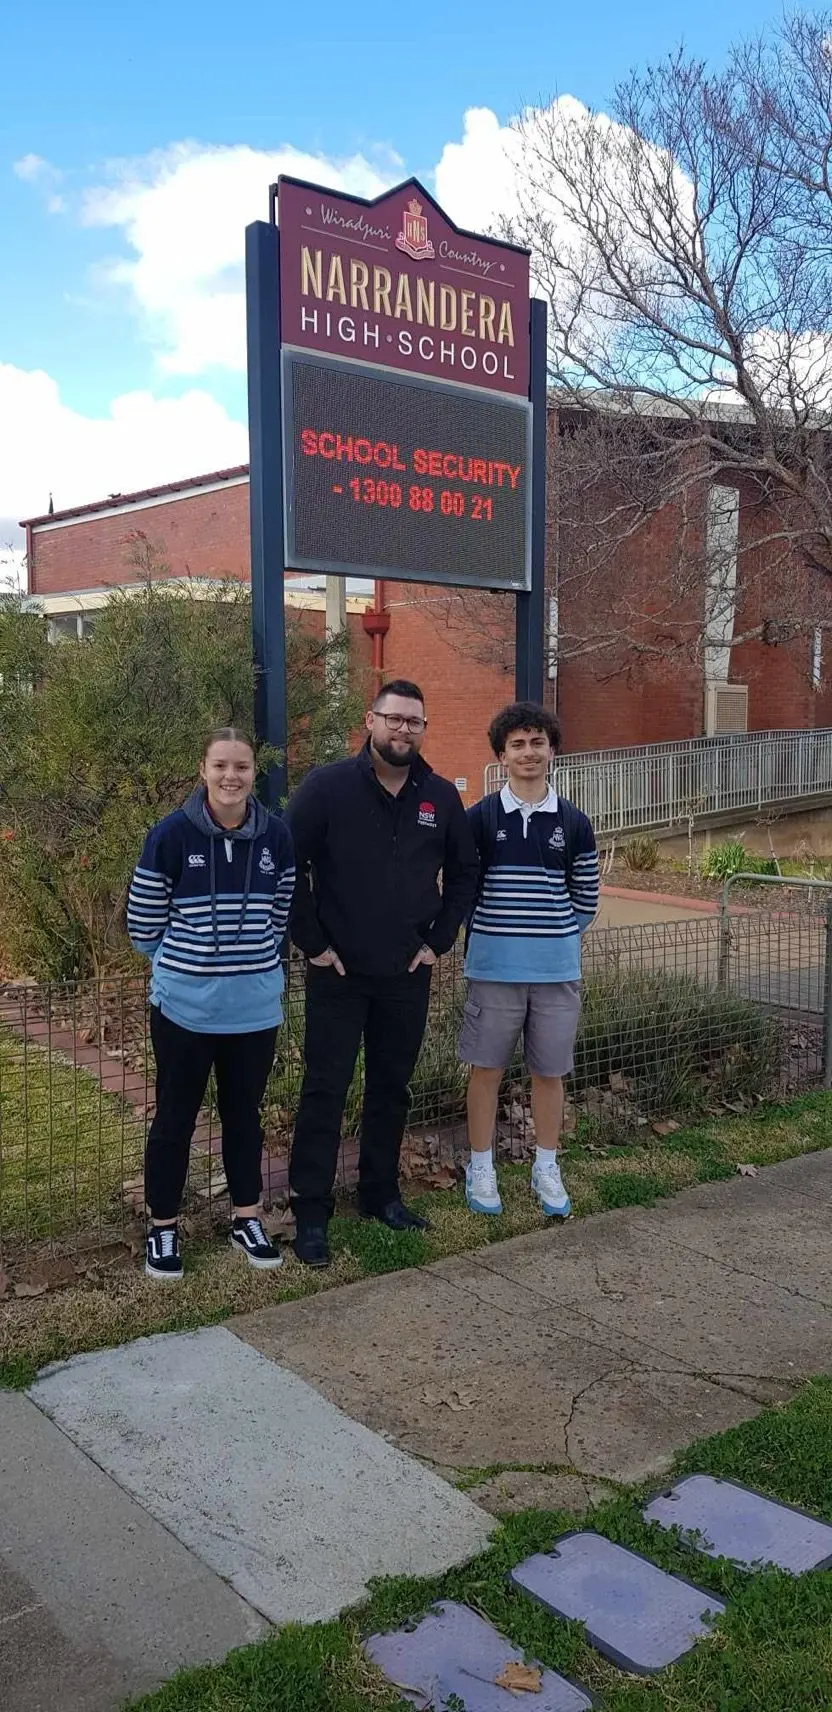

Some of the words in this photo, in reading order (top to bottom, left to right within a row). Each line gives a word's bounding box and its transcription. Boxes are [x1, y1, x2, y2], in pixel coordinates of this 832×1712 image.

[320, 203, 391, 240] Wiradjuri
[438, 240, 497, 276] Country
[300, 245, 515, 347] NARRANDERA
[300, 306, 380, 348] HIGH
[398, 330, 515, 379] SCHOOL
[301, 428, 406, 471] SCHOOL
[413, 447, 520, 488] SECURITY
[350, 476, 401, 508] 1300
[408, 484, 434, 513] 88
[440, 490, 464, 518] 00
[471, 494, 493, 521] 21
[419, 811, 435, 819] NSW
